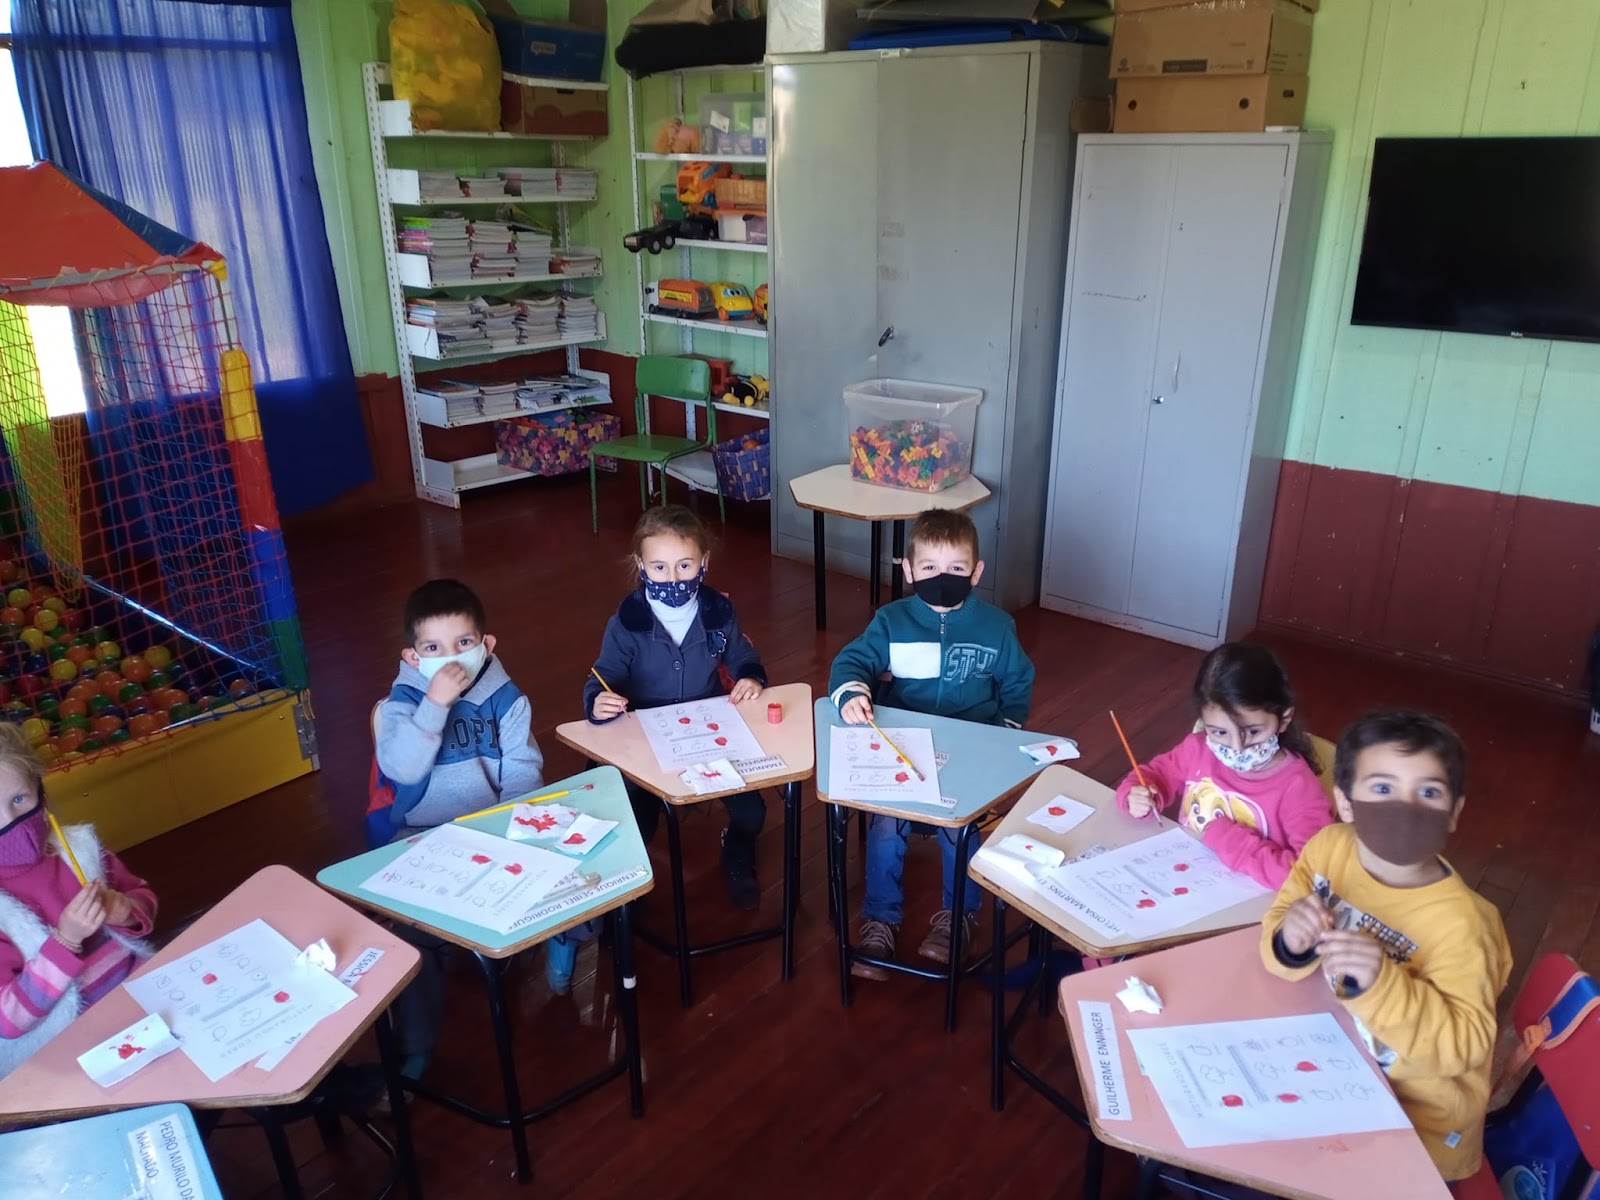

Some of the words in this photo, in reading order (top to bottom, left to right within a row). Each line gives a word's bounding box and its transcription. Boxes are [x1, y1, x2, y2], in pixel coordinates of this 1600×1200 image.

[1048, 885, 1086, 910] MARTINS
[1085, 907, 1122, 933] HELOISA
[1090, 1012, 1109, 1055] ENNINGER
[1099, 1059, 1120, 1116] GUILHERME
[135, 1130, 160, 1178] MACHADO
[159, 1120, 179, 1151] PEDRO
[168, 1150, 191, 1188] MURILO
